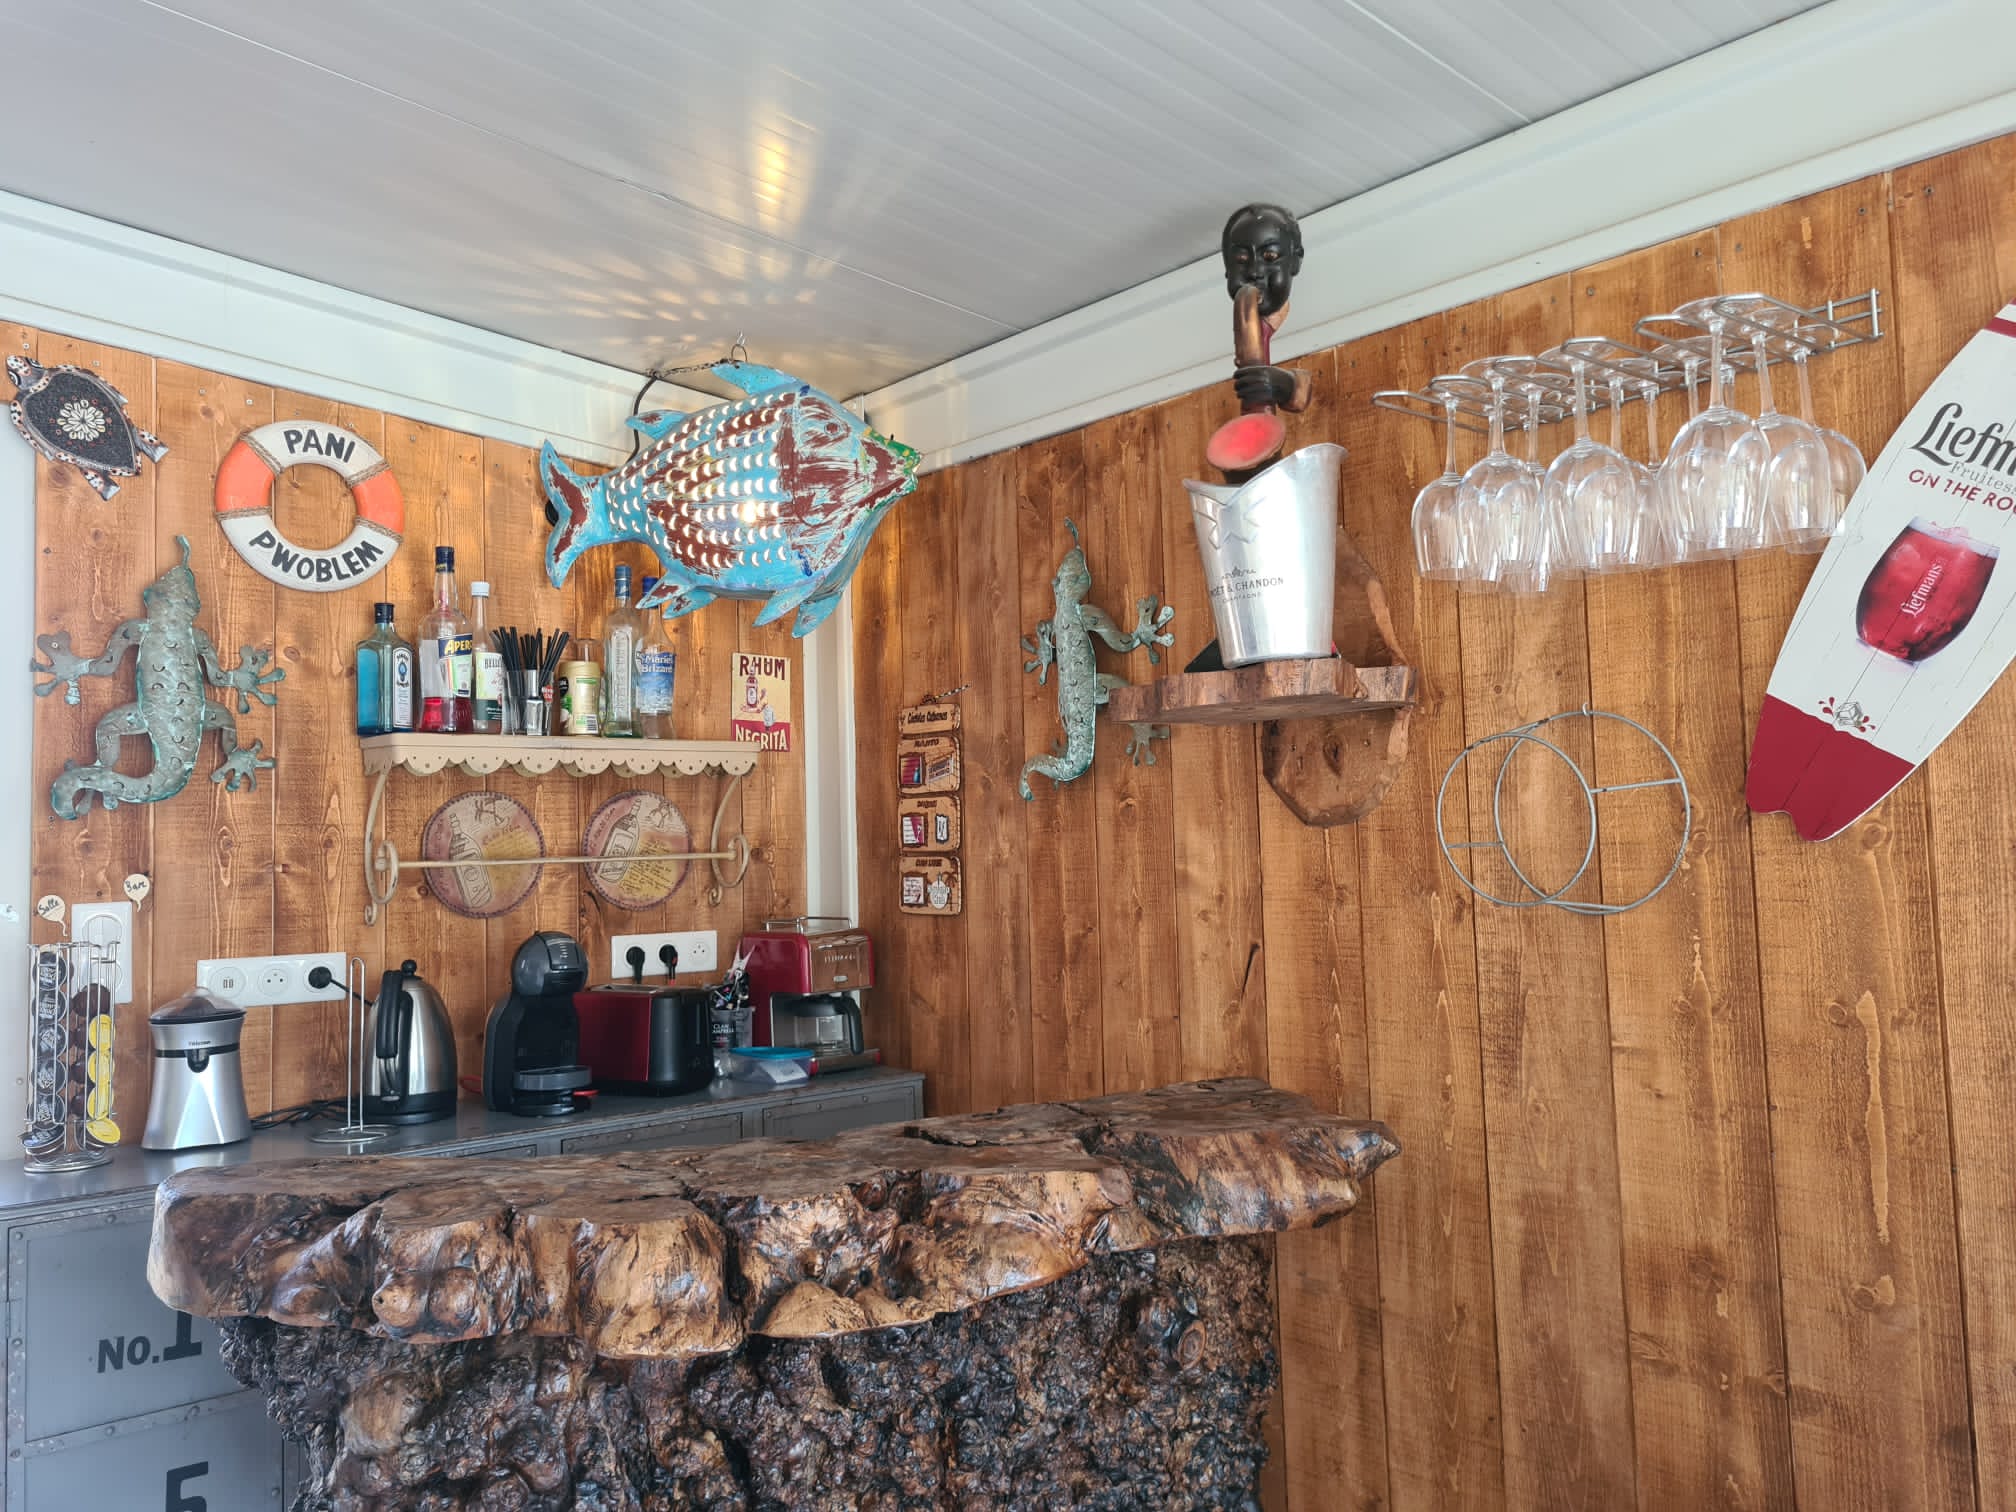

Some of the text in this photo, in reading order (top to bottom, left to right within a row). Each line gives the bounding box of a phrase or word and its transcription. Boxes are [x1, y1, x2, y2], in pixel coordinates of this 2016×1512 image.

[283, 429, 356, 463] PANI
[1908, 469, 2016, 514] ON THE RO
[249, 530, 384, 582] PWOBLEM
[1235, 577, 1284, 591] CHANDON
[1901, 563, 1942, 618] Liefmans
[444, 639, 473, 656] APER
[739, 655, 785, 681] RHUM
[735, 723, 788, 750] NEGRITA
